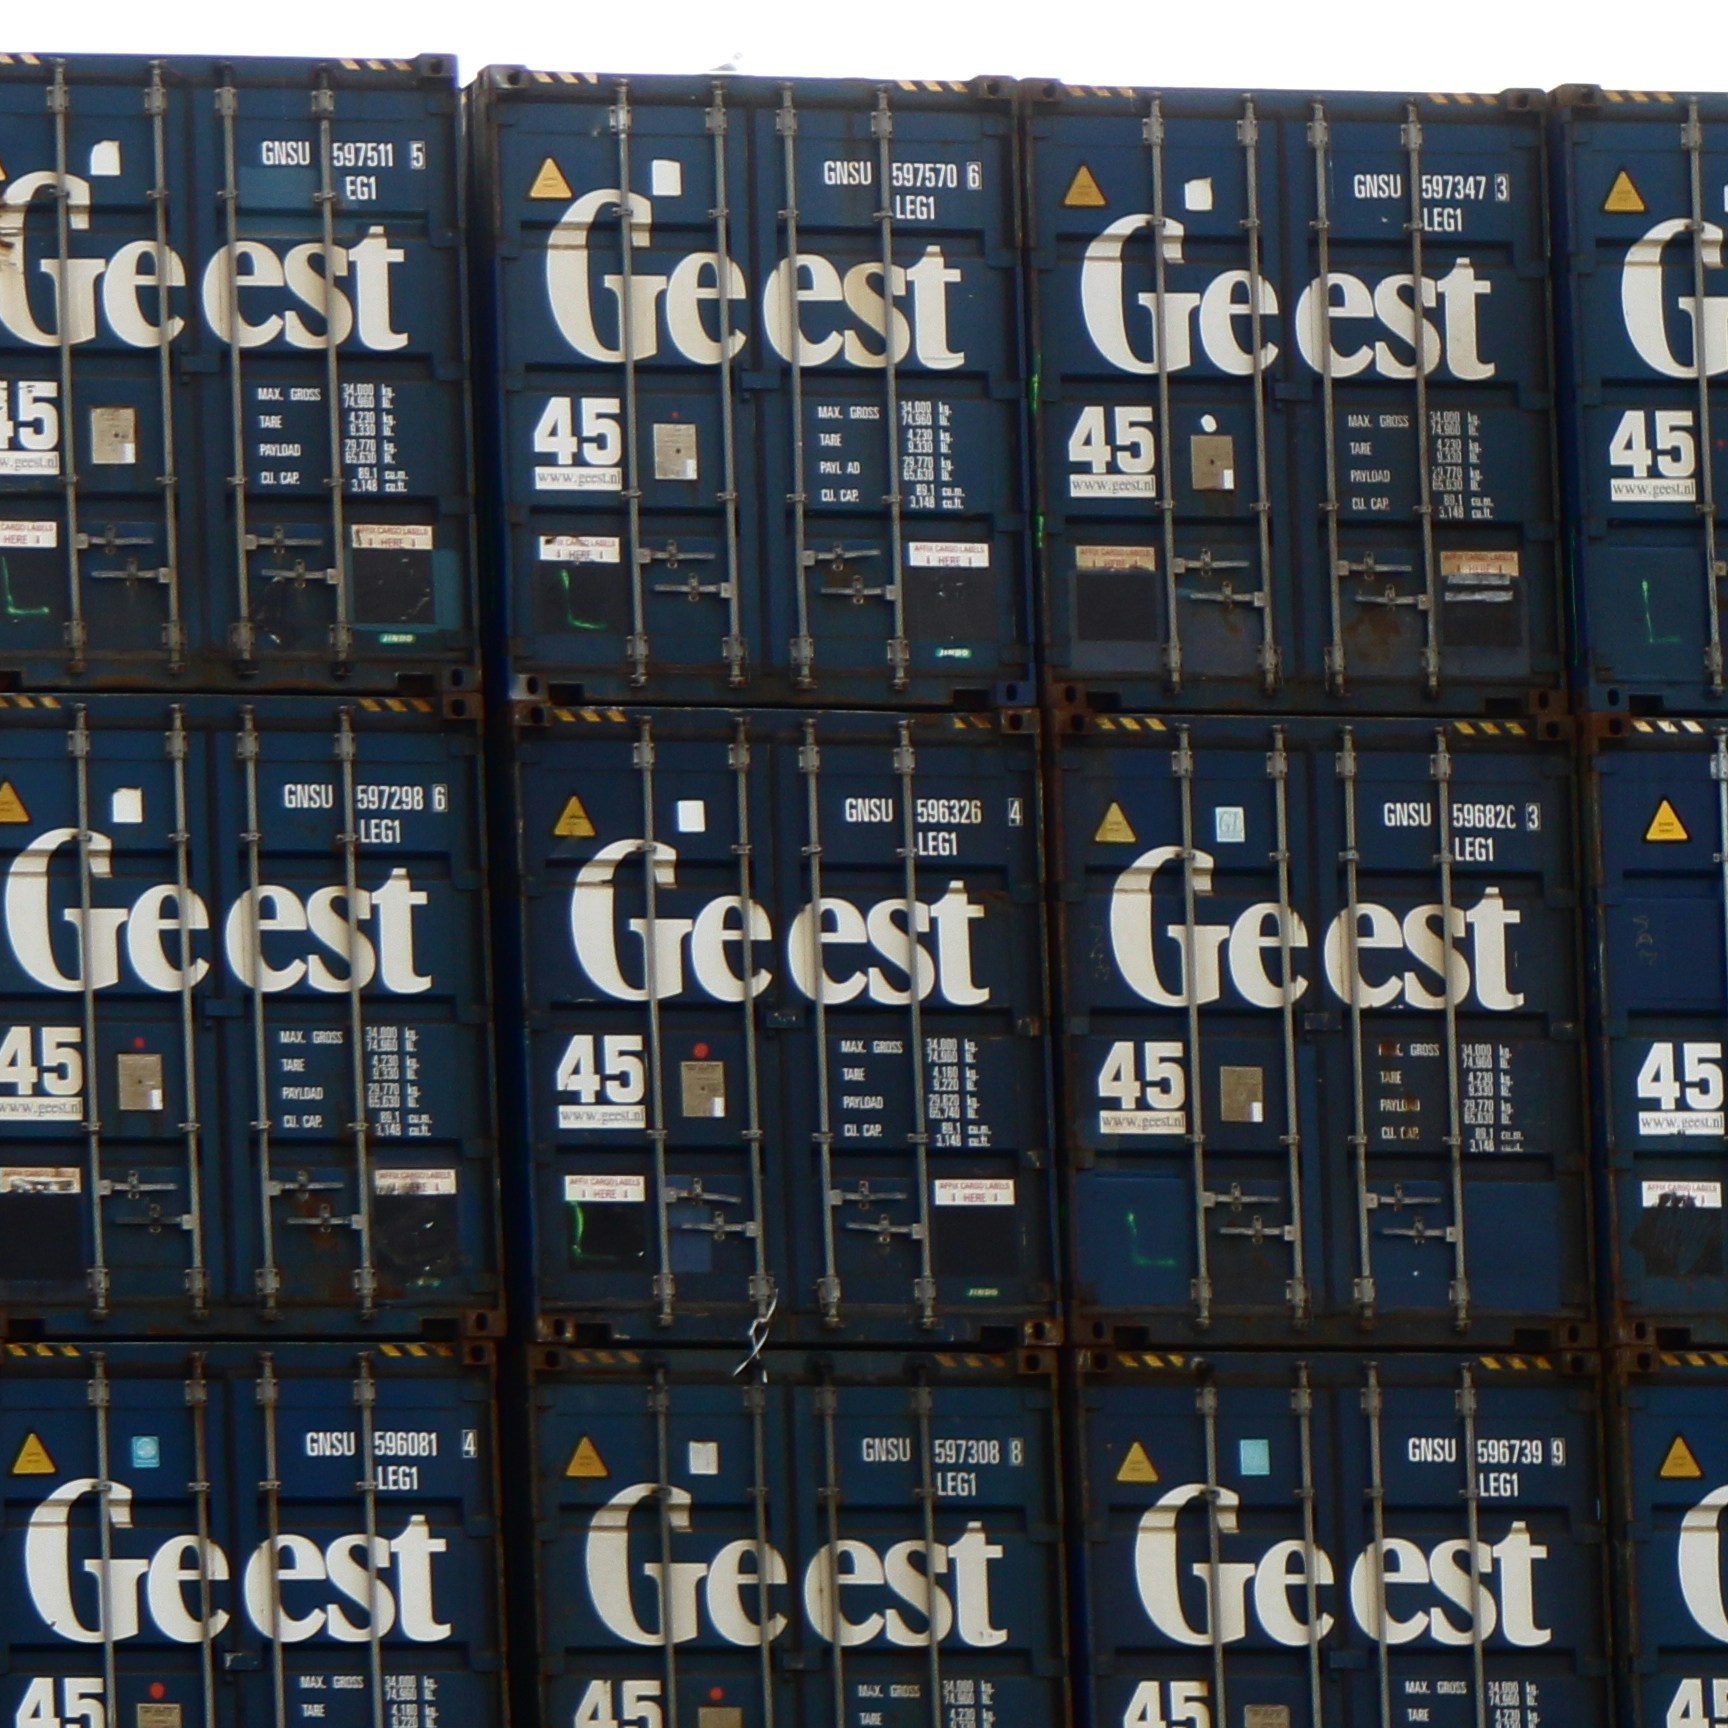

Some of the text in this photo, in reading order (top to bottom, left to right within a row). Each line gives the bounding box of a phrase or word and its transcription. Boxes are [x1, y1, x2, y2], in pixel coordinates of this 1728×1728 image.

[1355, 175, 1401, 198] GNSU
[1422, 176, 1486, 199] 597347
[1424, 208, 1461, 231] LEG1
[546, 188, 965, 367] Geest
[1081, 214, 1495, 379] Geest
[534, 397, 620, 465] 45
[1069, 407, 1154, 474] 45
[1610, 411, 1694, 483] 45
[846, 799, 981, 823] GNSU 596326
[919, 832, 956, 855] LEG1
[5, 827, 432, 994] Geest
[571, 839, 990, 1006] Geest
[1110, 846, 1524, 1010] Geest
[557, 1035, 643, 1103] 45
[1099, 1042, 1184, 1109] 45
[1638, 1043, 1723, 1110] 45
[1409, 1438, 1455, 1461] GNSU
[1478, 1440, 1542, 1463] 596739
[1480, 1473, 1518, 1496] LEG1
[24, 1478, 451, 1643] Geest
[586, 1482, 1008, 1646] Geest
[1135, 1483, 1550, 1646] Geest
